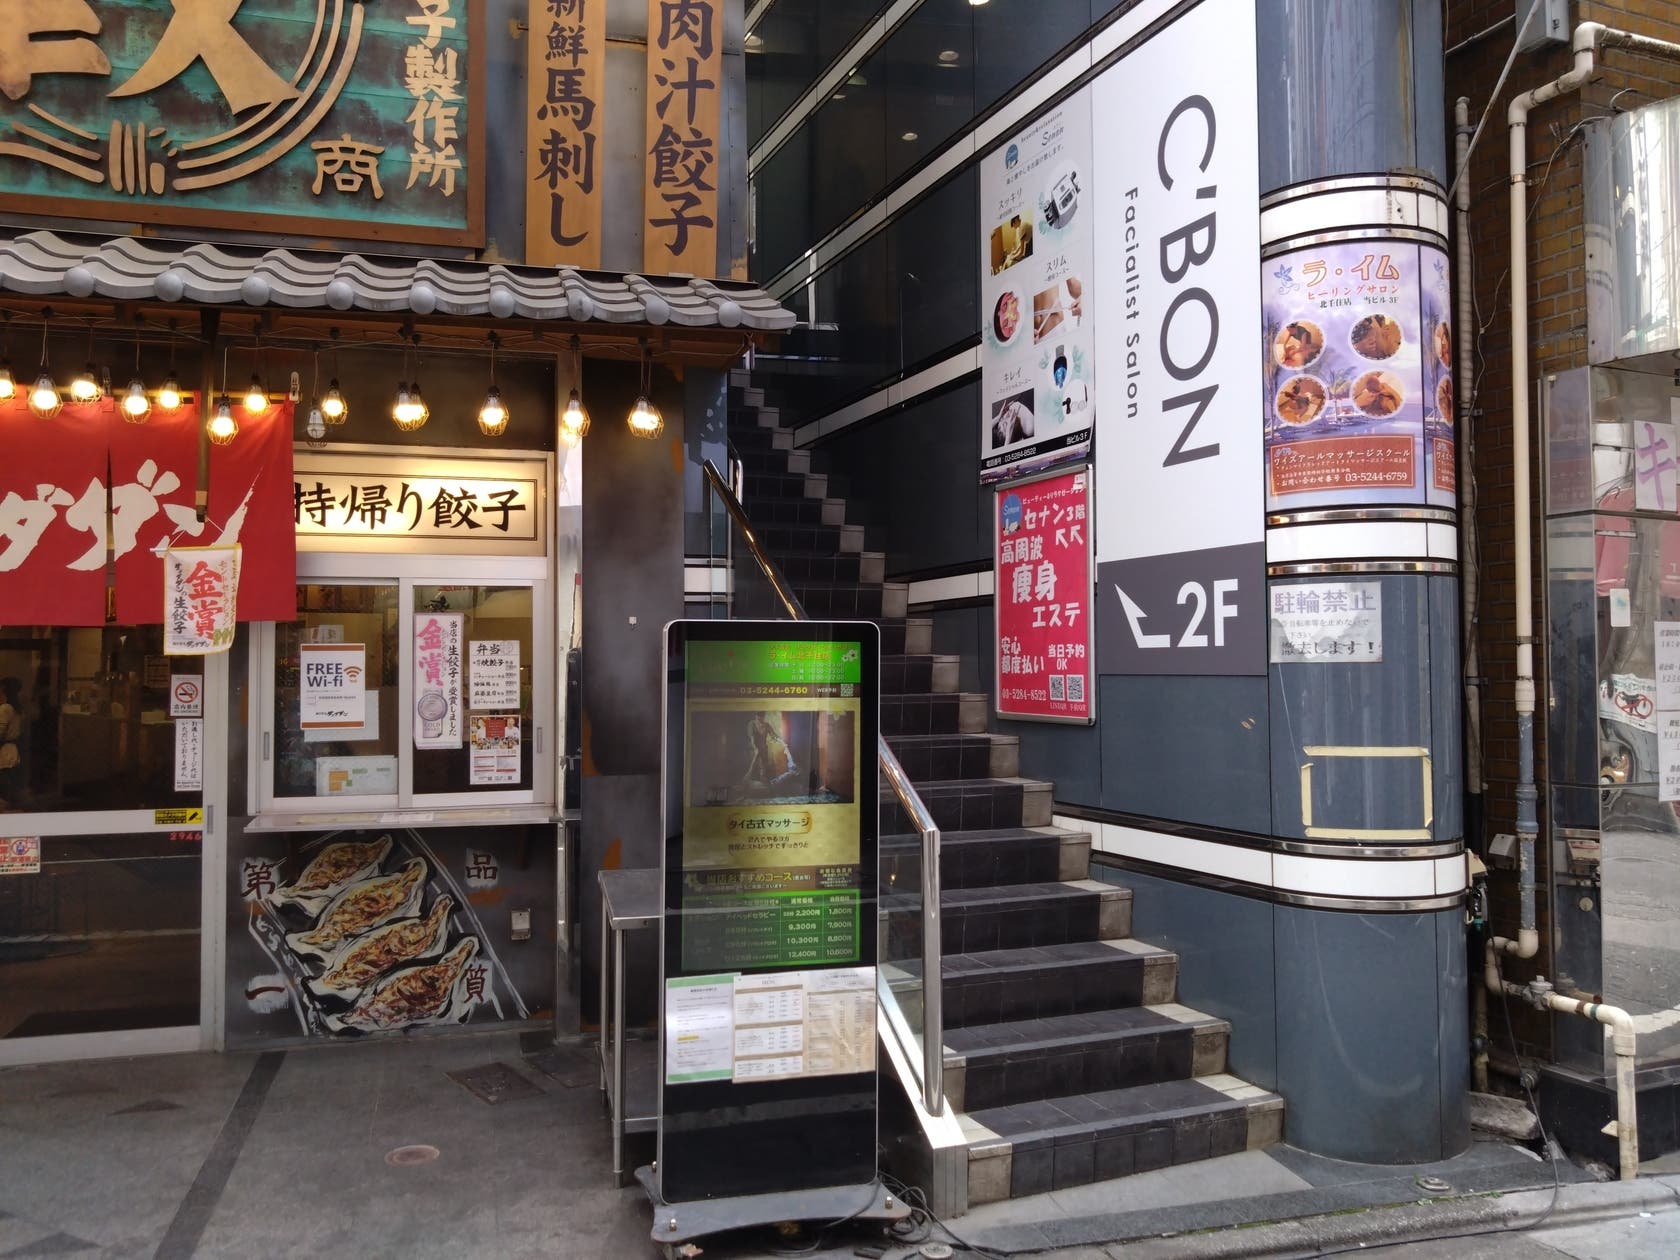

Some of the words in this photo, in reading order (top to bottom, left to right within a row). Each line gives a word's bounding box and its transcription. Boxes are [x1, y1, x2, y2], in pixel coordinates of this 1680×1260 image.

[405, 0, 465, 197] 子製作所
[648, 0, 716, 257] 肉汁餃子
[311, 133, 385, 199] 商
[998, 186, 1022, 210] スッキリ
[1046, 255, 1067, 273] スリム
[1125, 186, 1140, 321] Facialist
[1302, 255, 1400, 287] ラ・イム
[1307, 285, 1400, 300] ヒーリングサロン
[1319, 296, 1352, 308] 北千住店
[1003, 367, 1022, 383] キレイ
[1126, 331, 1140, 419] Salon
[1274, 448, 1411, 466] ワイズアールマッサージスクール
[1636, 423, 1670, 511] キ
[1344, 471, 1408, 483] 03-5244-6759
[294, 481, 526, 532] 持帰り餃子
[1024, 502, 1086, 530] セナン3階
[1001, 534, 1043, 564] 高周波
[1012, 560, 1058, 604] 痩身
[184, 560, 224, 640] 金賞
[1176, 578, 1239, 647] 2F
[1274, 589, 1377, 615] 駐輪禁止
[1032, 602, 1081, 628] エステ
[416, 618, 444, 687] 金賞
[477, 643, 501, 656] 弁当
[1001, 636, 1021, 654] 安心
[1048, 643, 1085, 658] 当日予約
[306, 662, 343, 676] FREE
[1001, 655, 1045, 675] 都度払い
[1056, 658, 1068, 670] OK
[740, 686, 808, 694] 03-5244-6760
[728, 816, 811, 830] タイ古式マッサージ
[241, 860, 277, 900] 第
[465, 852, 498, 881] 品
[463, 964, 488, 1003] 質
